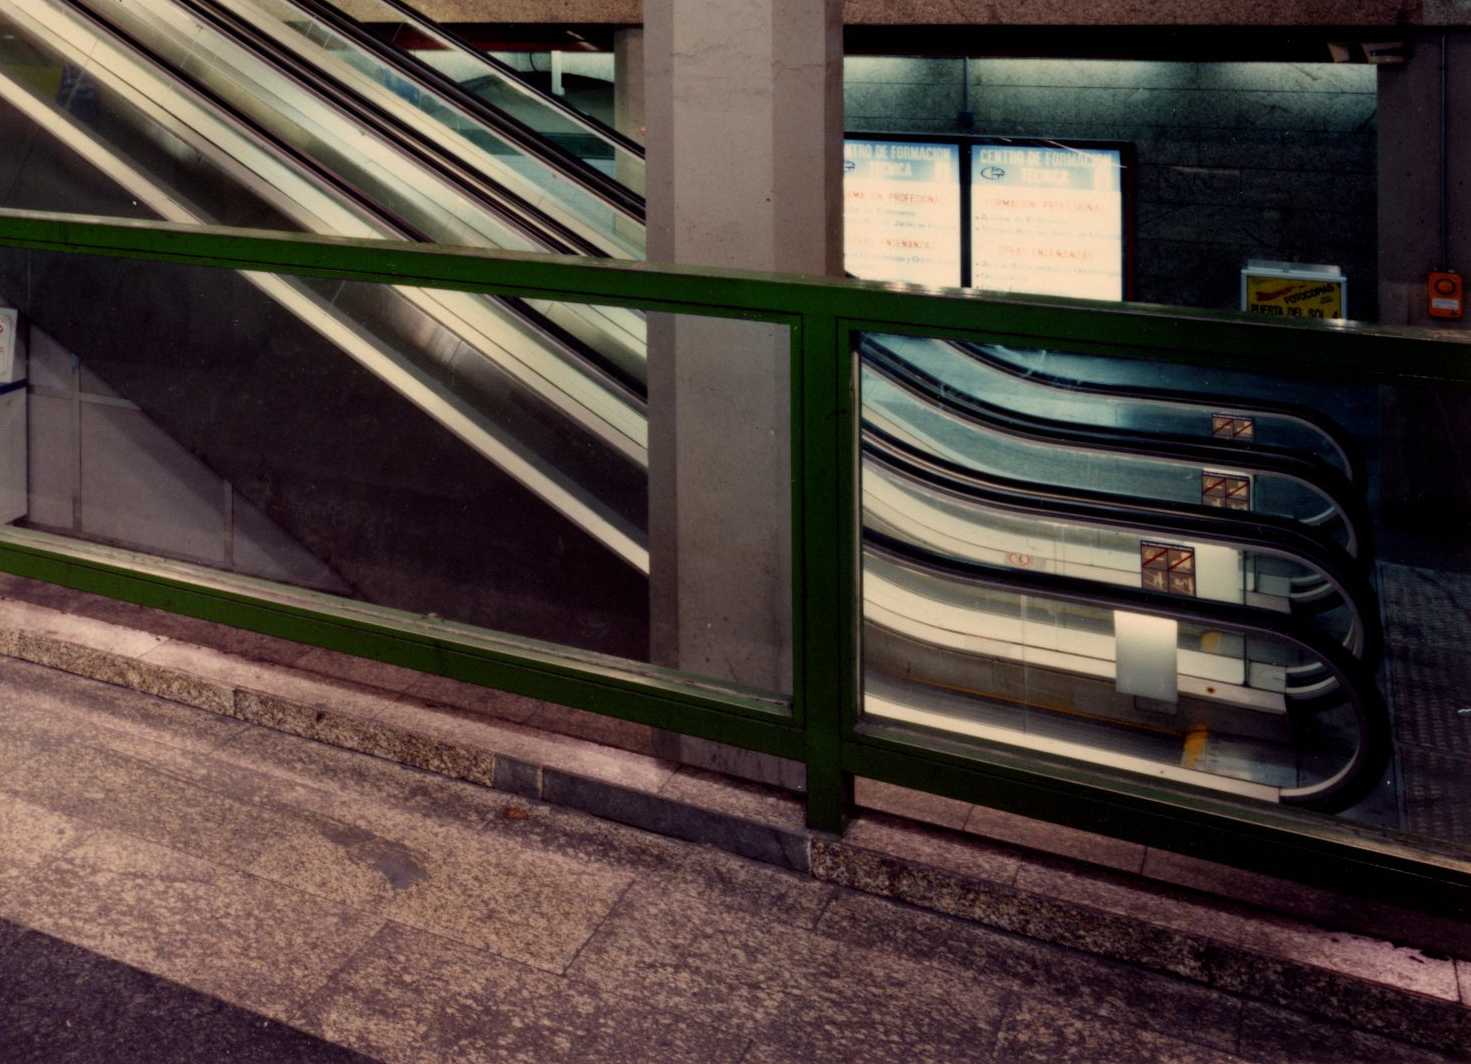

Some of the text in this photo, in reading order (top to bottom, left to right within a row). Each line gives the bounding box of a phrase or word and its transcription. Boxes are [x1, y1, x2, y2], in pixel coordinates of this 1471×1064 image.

[844, 142, 951, 161] NTRO DE FORMACION
[980, 148, 1027, 165] CENTRO
[1029, 150, 1043, 165] DE
[1283, 283, 1334, 305] FOTOCOPIAS
[1251, 304, 1283, 315] PUERTA
[1287, 306, 1302, 317] DEL
